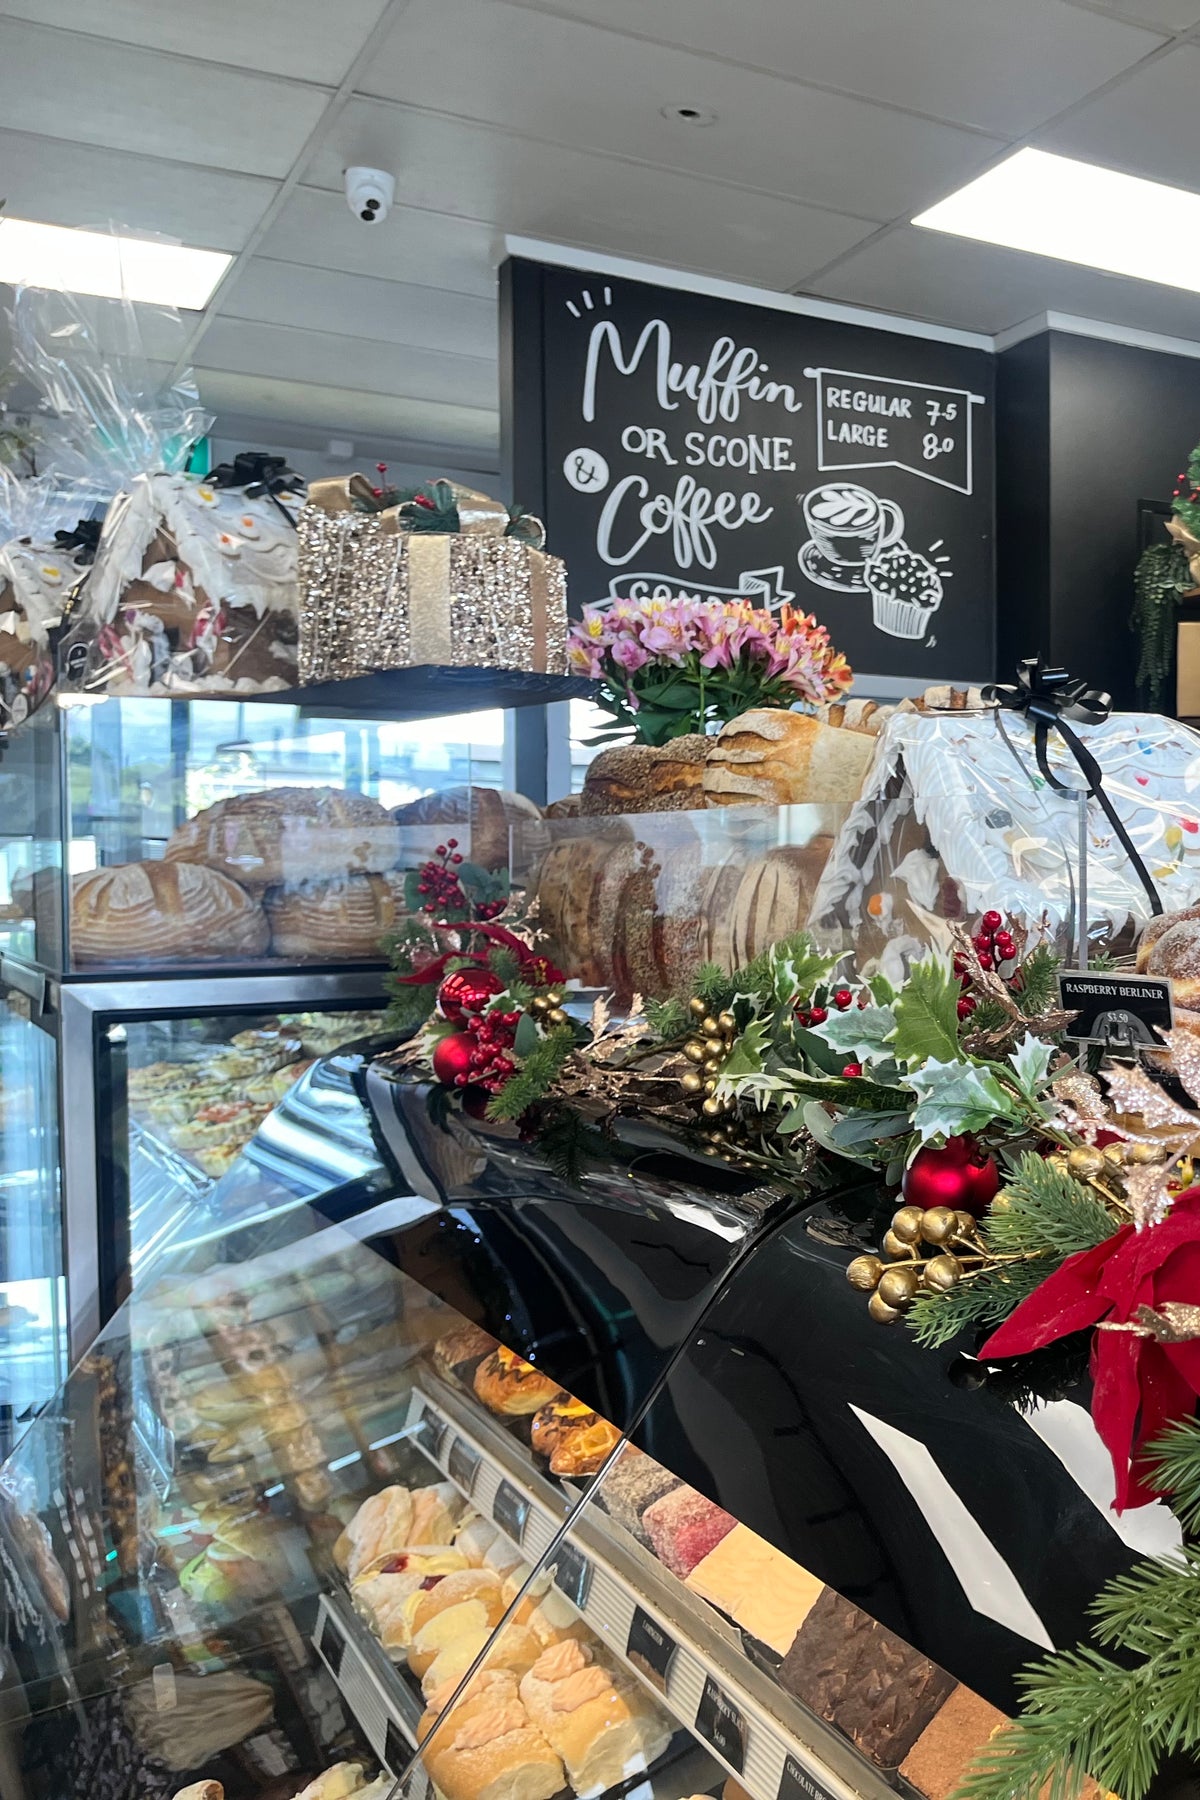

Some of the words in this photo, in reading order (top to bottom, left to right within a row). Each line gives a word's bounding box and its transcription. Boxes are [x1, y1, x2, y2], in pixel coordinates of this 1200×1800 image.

[582, 318, 803, 424] Muffin
[826, 387, 912, 419] REGULAR
[621, 425, 679, 466] OR
[684, 431, 796, 474] SCONE
[827, 419, 889, 448] LARGE
[596, 474, 774, 569] Coffee
[1065, 983, 1117, 996] RASPBERRY
[1120, 986, 1164, 999] BERLINER
[1107, 1012, 1129, 1024] $3.50
[786, 1761, 816, 1797] CHOCOLATE
